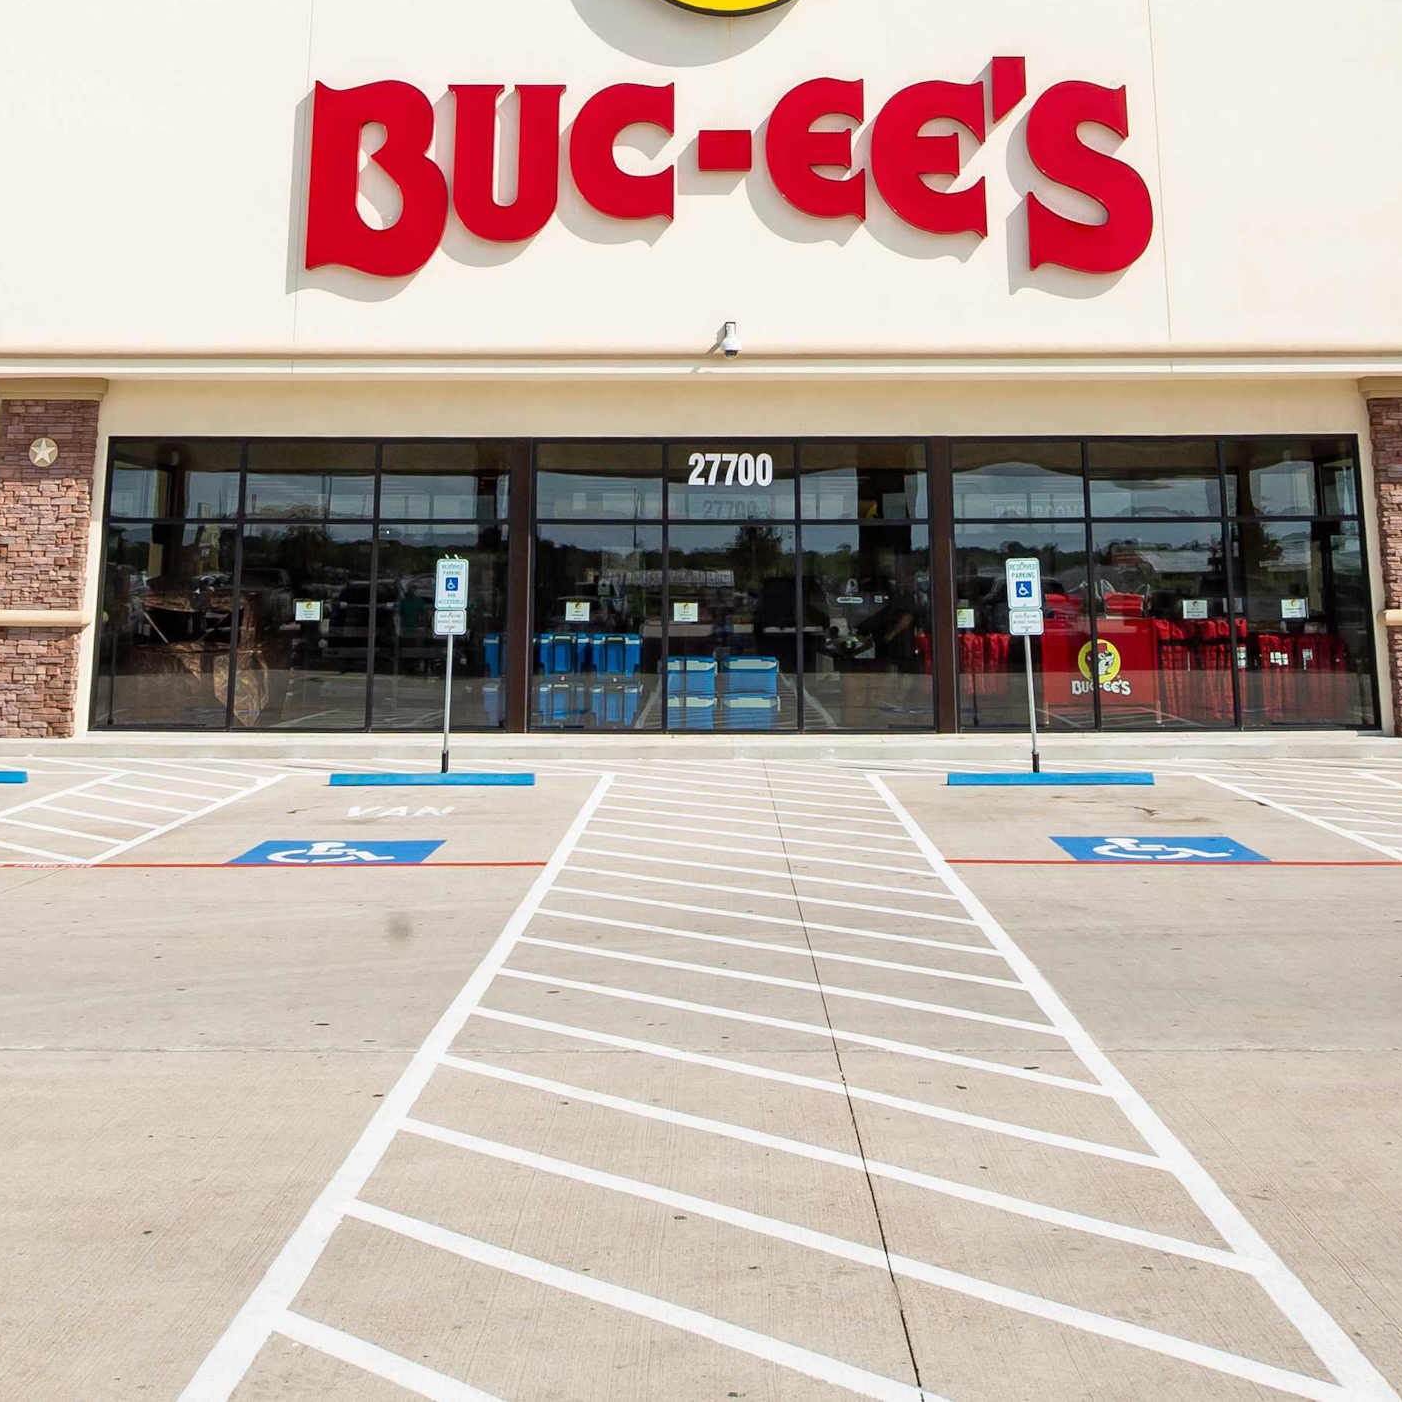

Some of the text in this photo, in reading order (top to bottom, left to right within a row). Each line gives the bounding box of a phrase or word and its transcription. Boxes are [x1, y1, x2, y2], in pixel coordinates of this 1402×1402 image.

[304, 56, 1154, 279] BUC-EE'S
[687, 452, 773, 487] 27700
[347, 805, 455, 817] VAN
